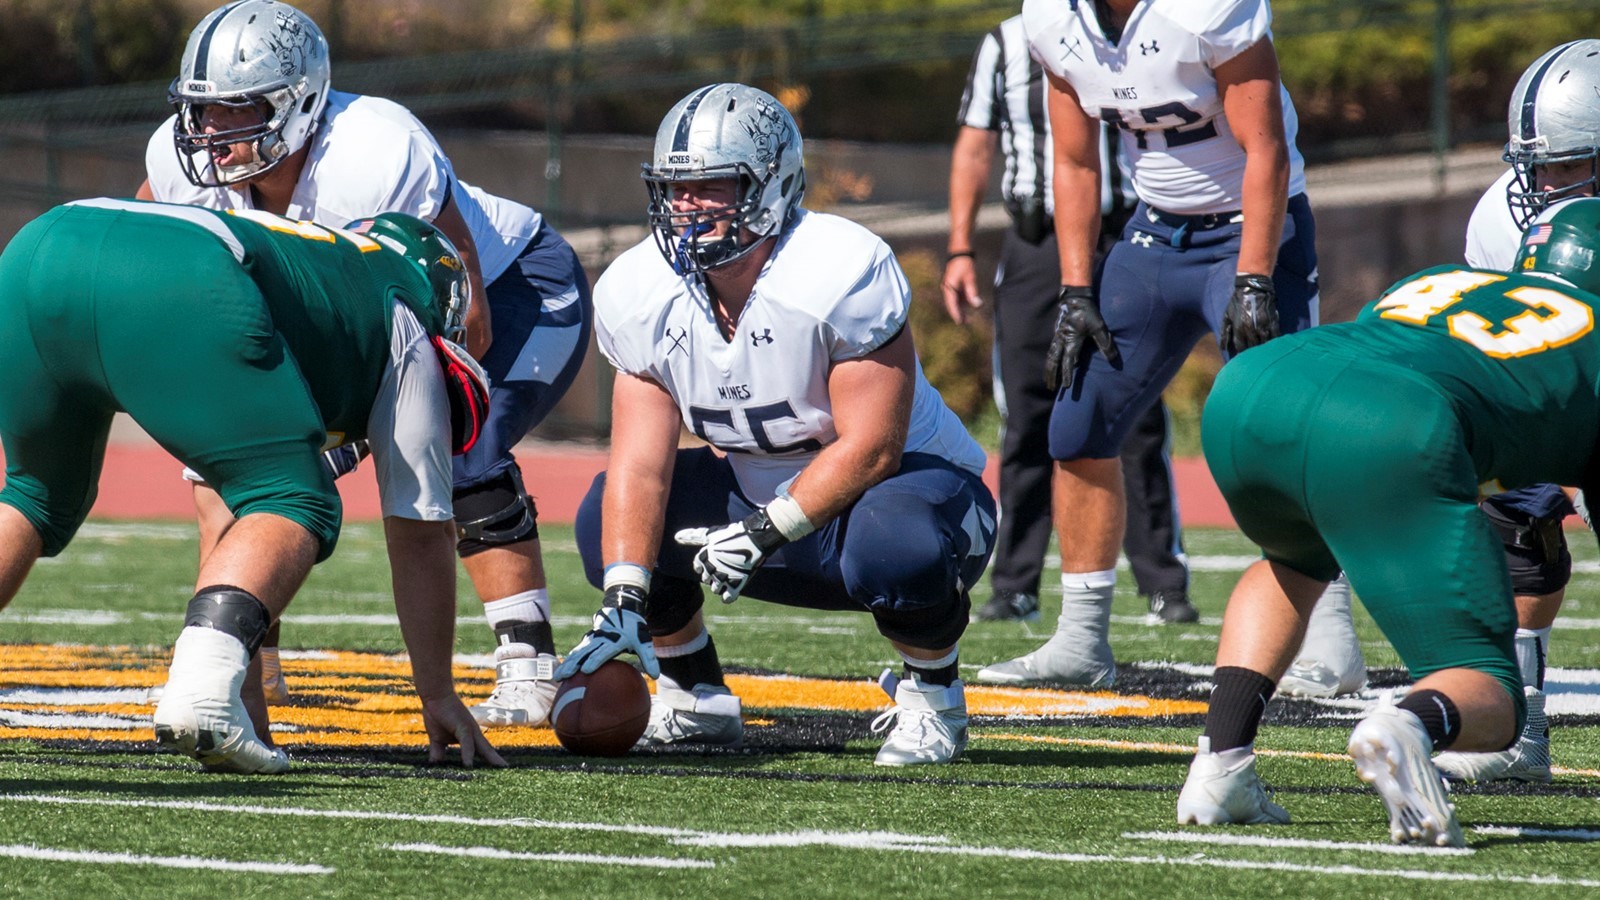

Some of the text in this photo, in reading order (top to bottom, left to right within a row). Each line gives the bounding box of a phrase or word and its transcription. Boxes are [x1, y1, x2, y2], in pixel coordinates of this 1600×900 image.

[1112, 87, 1138, 100] MINES
[668, 155, 690, 164] MINES
[1373, 270, 1595, 360] 43
[717, 384, 752, 400] MINES
